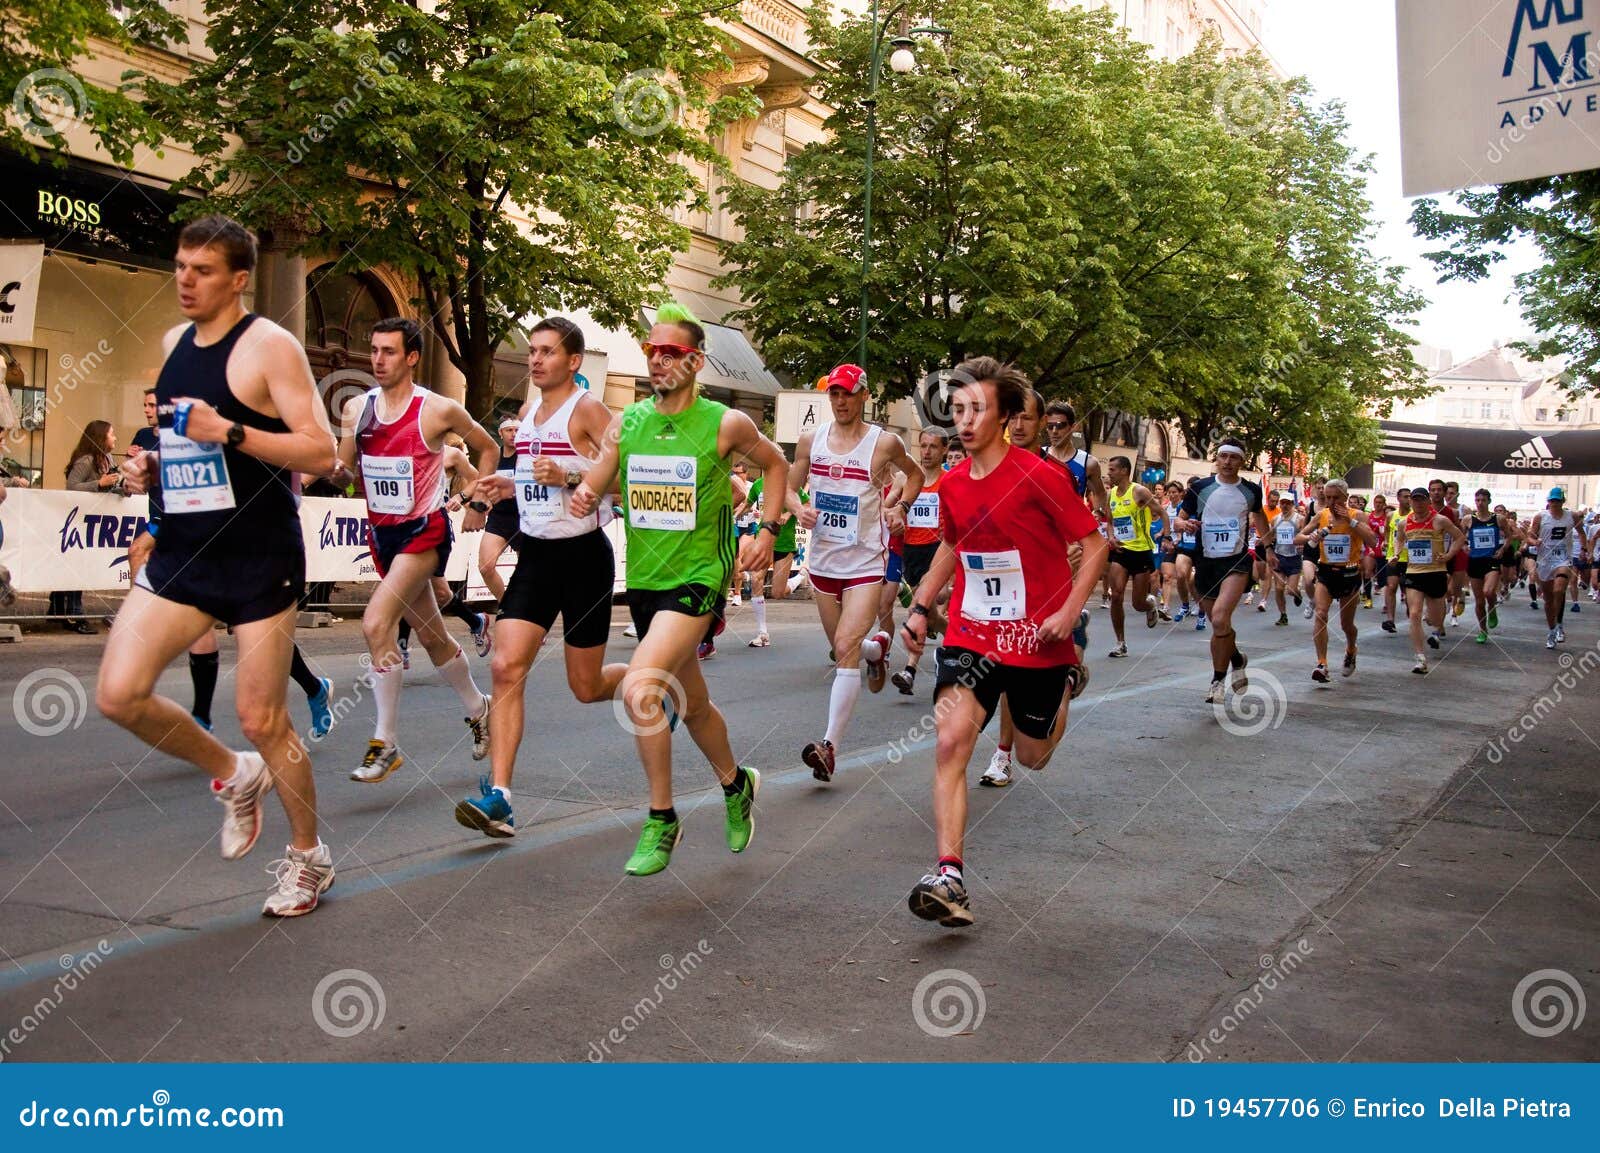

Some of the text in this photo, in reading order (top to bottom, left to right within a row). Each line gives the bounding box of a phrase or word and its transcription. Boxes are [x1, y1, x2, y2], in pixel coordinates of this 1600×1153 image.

[38, 190, 101, 224] BOSS
[38, 214, 67, 226] HUGO
[705, 354, 751, 381] Dior
[547, 431, 562, 440] POL
[847, 459, 860, 467] POL
[1503, 456, 1562, 469] adidas
[166, 461, 219, 488] 18021
[630, 465, 672, 475] Volkswagen
[373, 480, 399, 496] 109
[524, 484, 549, 502] 644
[630, 486, 693, 513] ONDRÁČEK
[913, 506, 930, 517] 108
[823, 512, 847, 528] 266
[1214, 532, 1230, 542] 717
[1327, 545, 1344, 555] 540
[983, 577, 1001, 597] 17
